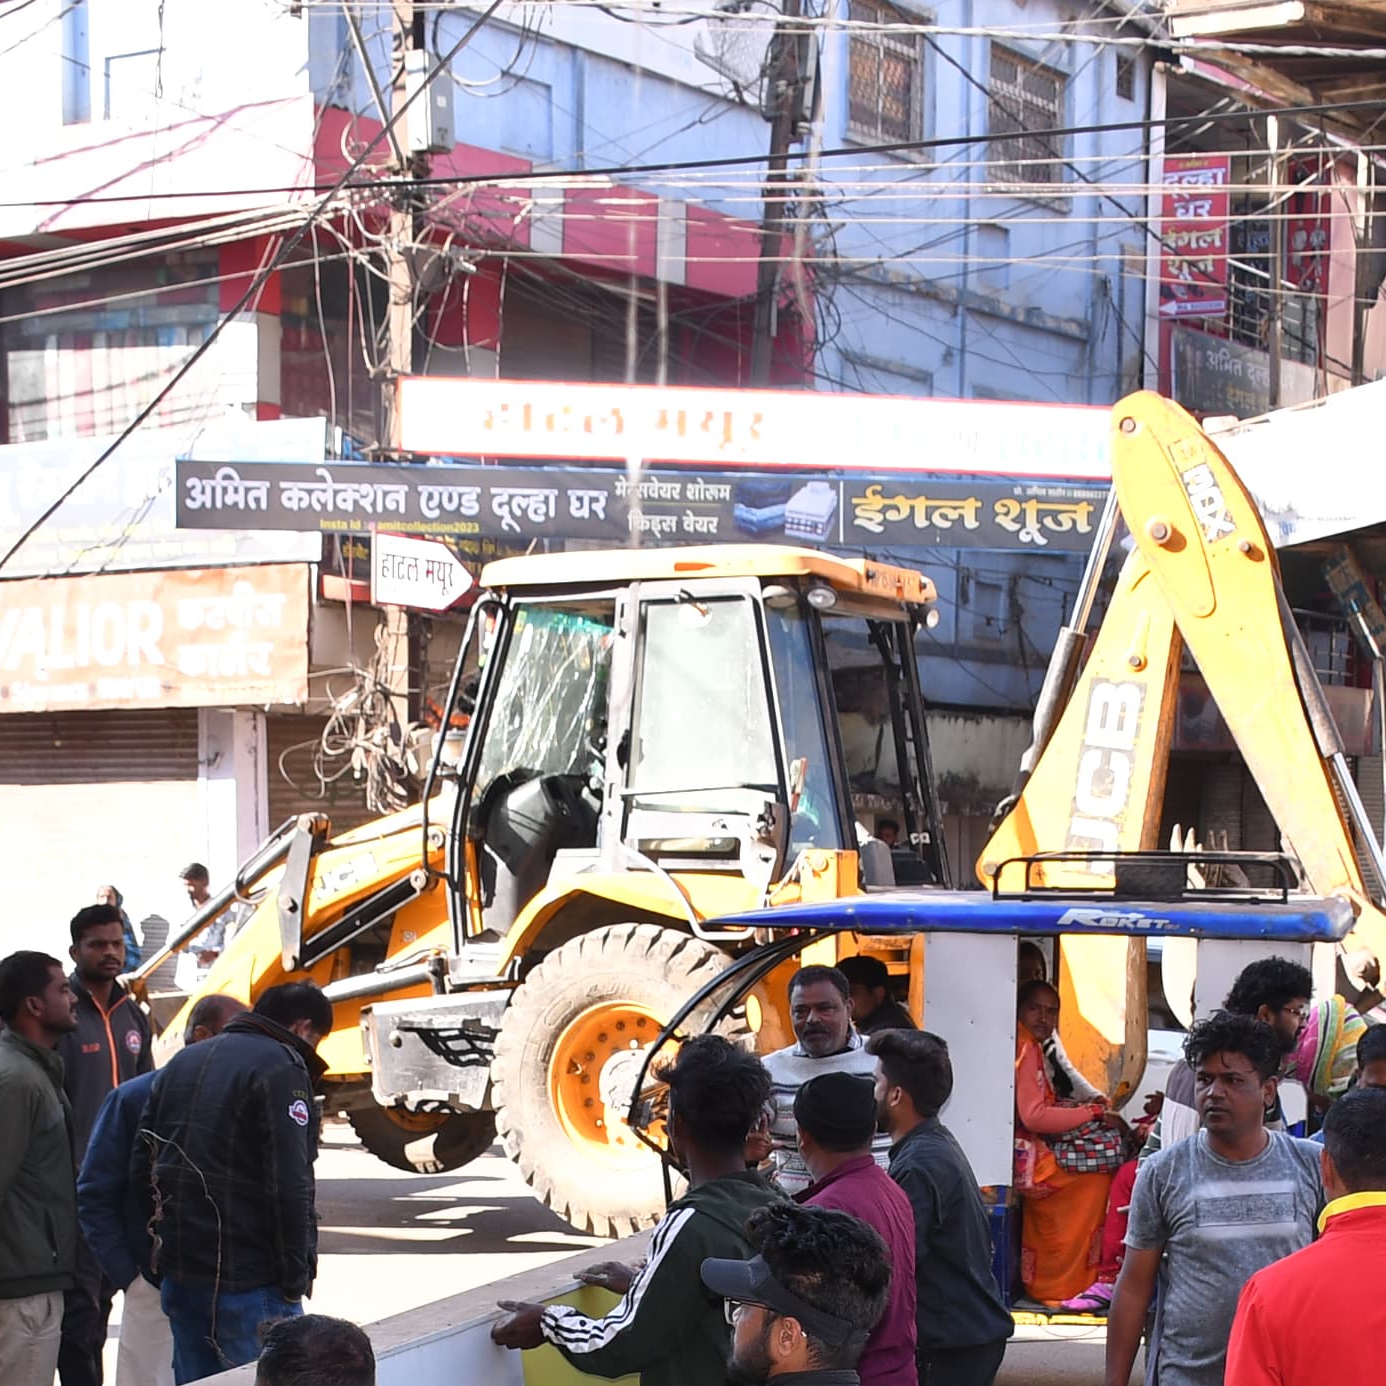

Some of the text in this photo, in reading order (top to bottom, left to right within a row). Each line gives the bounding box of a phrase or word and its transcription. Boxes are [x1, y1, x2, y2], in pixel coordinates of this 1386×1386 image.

[184, 466, 271, 512] अमित
[279, 467, 409, 515] कलेक्शन
[417, 484, 482, 519] एण्ड
[490, 488, 559, 532] दूल्हा
[567, 488, 608, 521] घर
[319, 518, 349, 531] Insta
[682, 510, 719, 534] वेयर
[852, 484, 1095, 546] ईगल शूज
[1069, 682, 1142, 875] JCB
